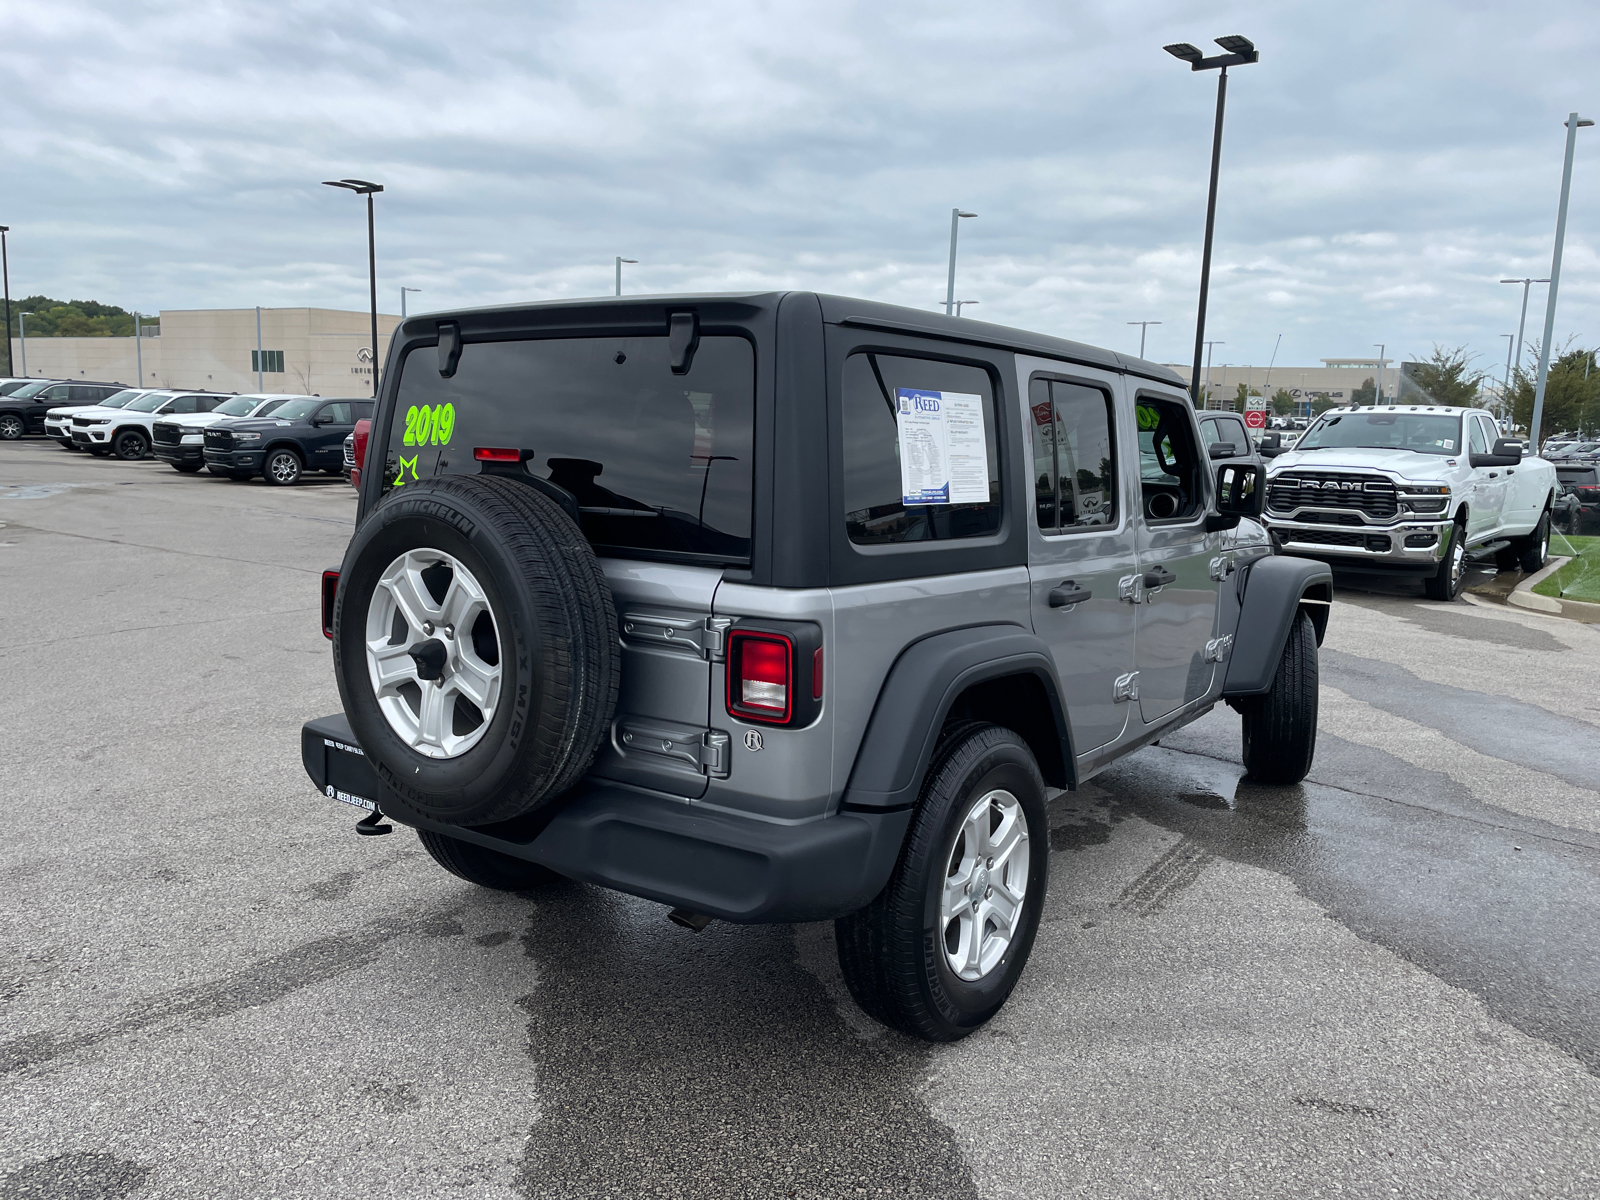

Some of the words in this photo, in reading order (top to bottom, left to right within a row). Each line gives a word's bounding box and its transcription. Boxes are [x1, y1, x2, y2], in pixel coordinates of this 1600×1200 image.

[914, 395, 940, 412] REED
[403, 402, 456, 446] 2019
[1301, 480, 1362, 491] RAM
[401, 500, 475, 534] MICHELIN
[336, 790, 376, 811] REEDJEEP.COM
